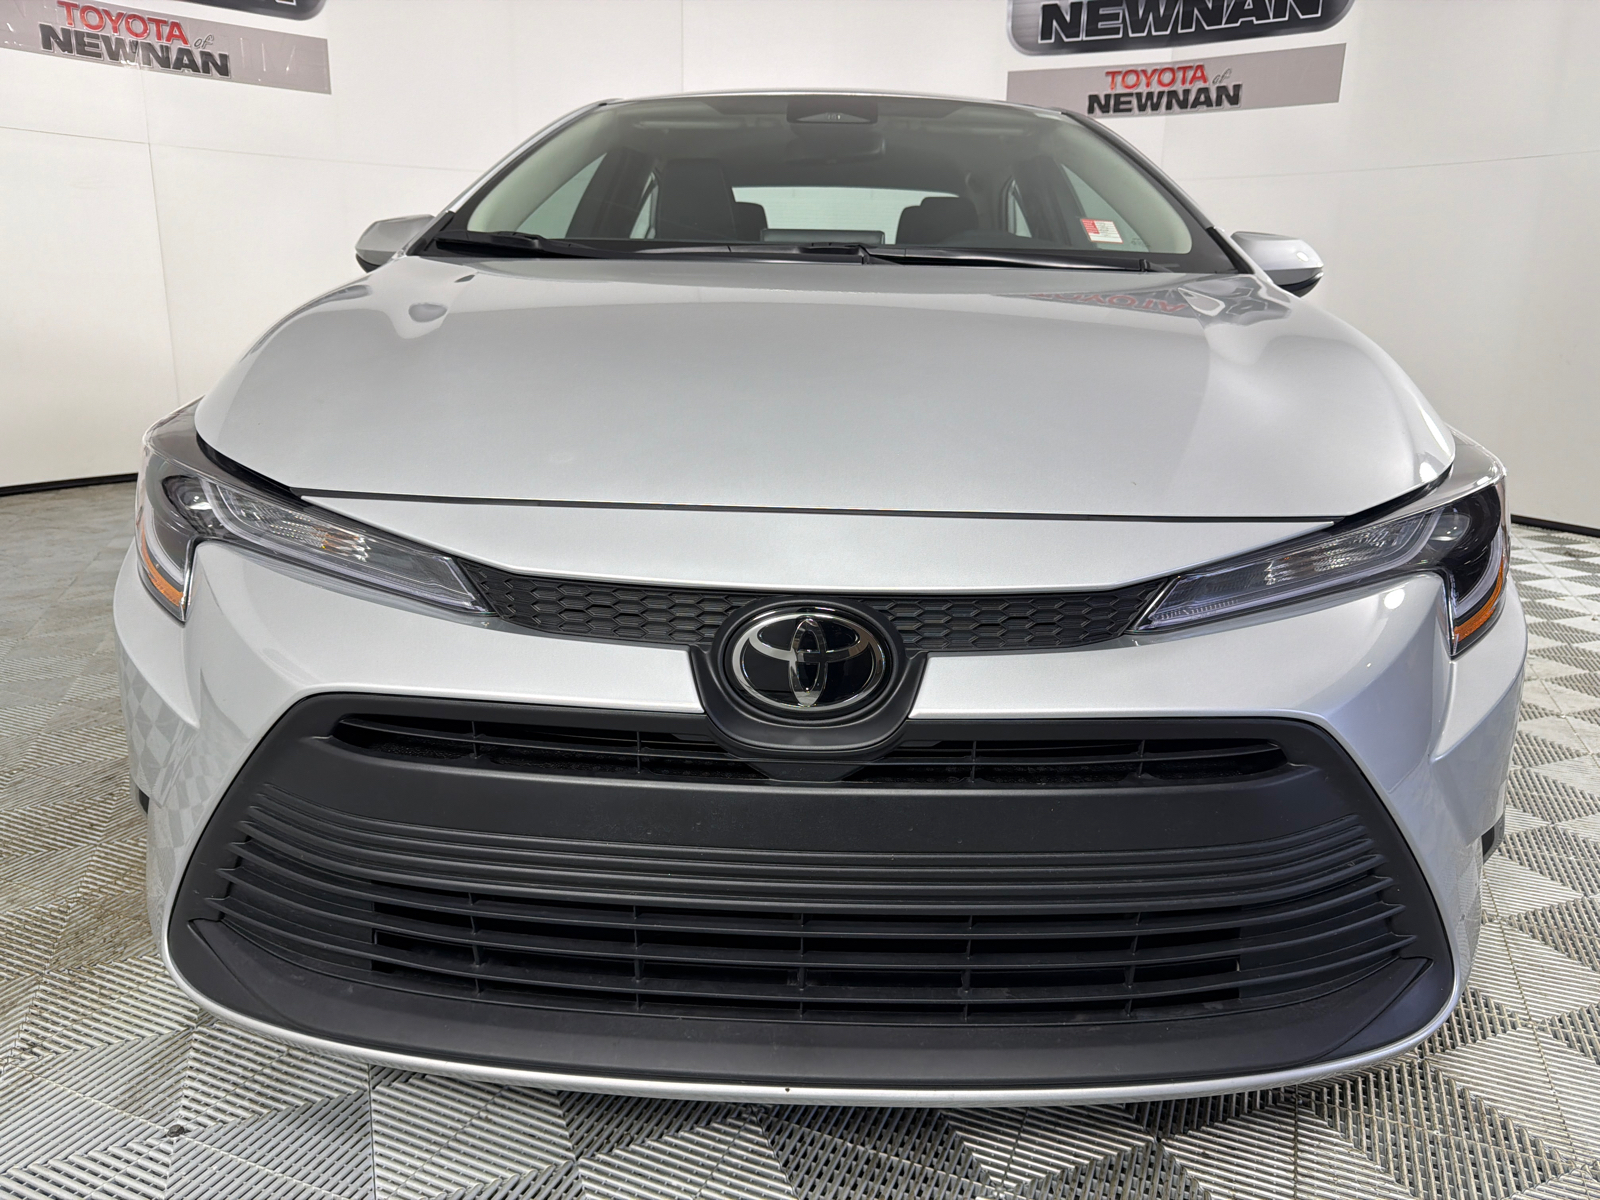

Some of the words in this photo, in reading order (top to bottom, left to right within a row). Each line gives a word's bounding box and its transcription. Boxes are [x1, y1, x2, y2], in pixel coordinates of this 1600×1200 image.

[57, 1, 189, 45] TOYOTA
[193, 34, 215, 49] of
[39, 24, 230, 77] NEWNAN
[1105, 65, 1208, 90] TOYOTA
[1087, 84, 1241, 115] NEWNAN
